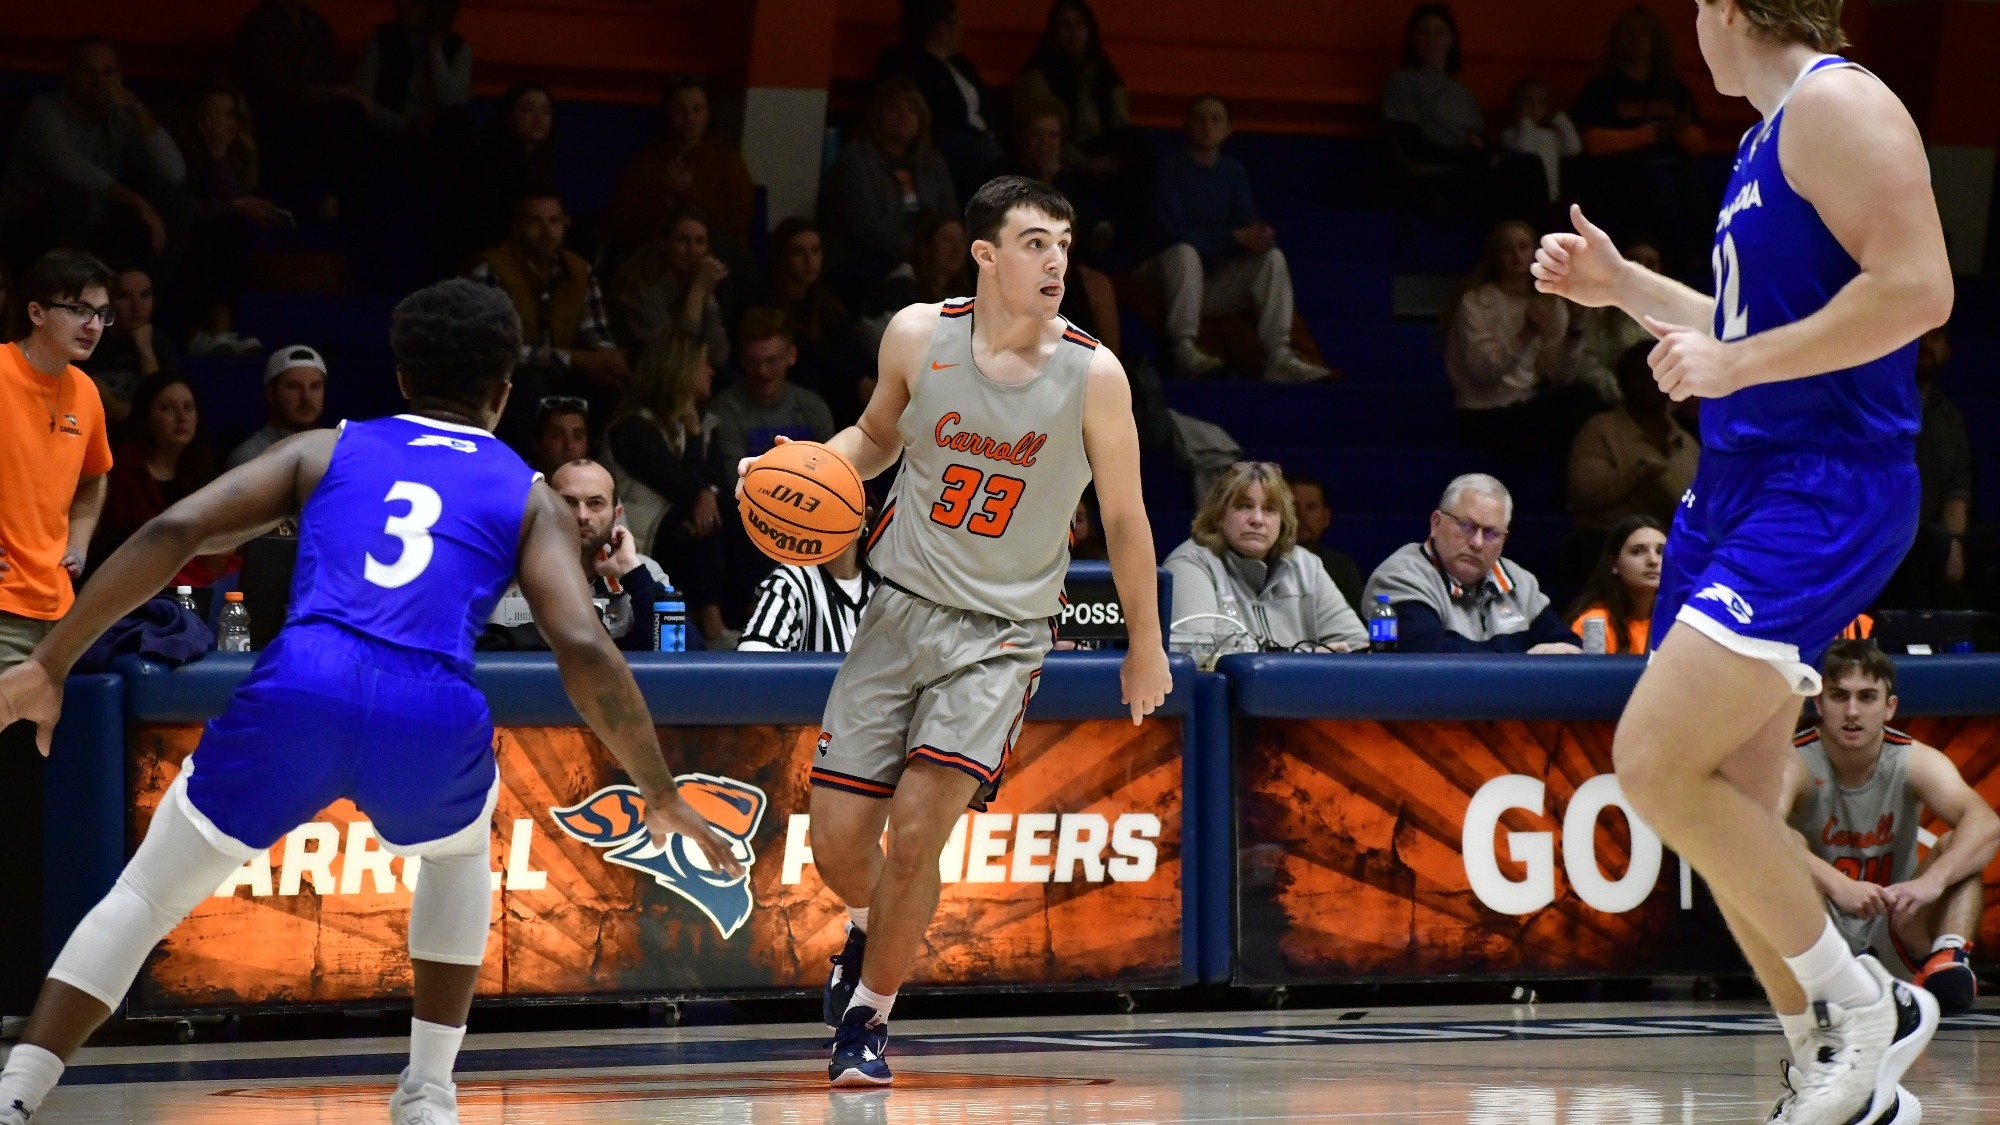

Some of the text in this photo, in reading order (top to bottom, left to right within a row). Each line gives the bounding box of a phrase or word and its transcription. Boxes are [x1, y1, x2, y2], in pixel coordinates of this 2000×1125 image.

[934, 411, 1047, 467] Carroll
[770, 484, 821, 513] EVO
[930, 464, 1026, 538] 33
[364, 480, 442, 588] 3
[747, 505, 823, 555] Wilson
[1061, 602, 1125, 625] POSS.
[1462, 773, 1663, 915] GO
